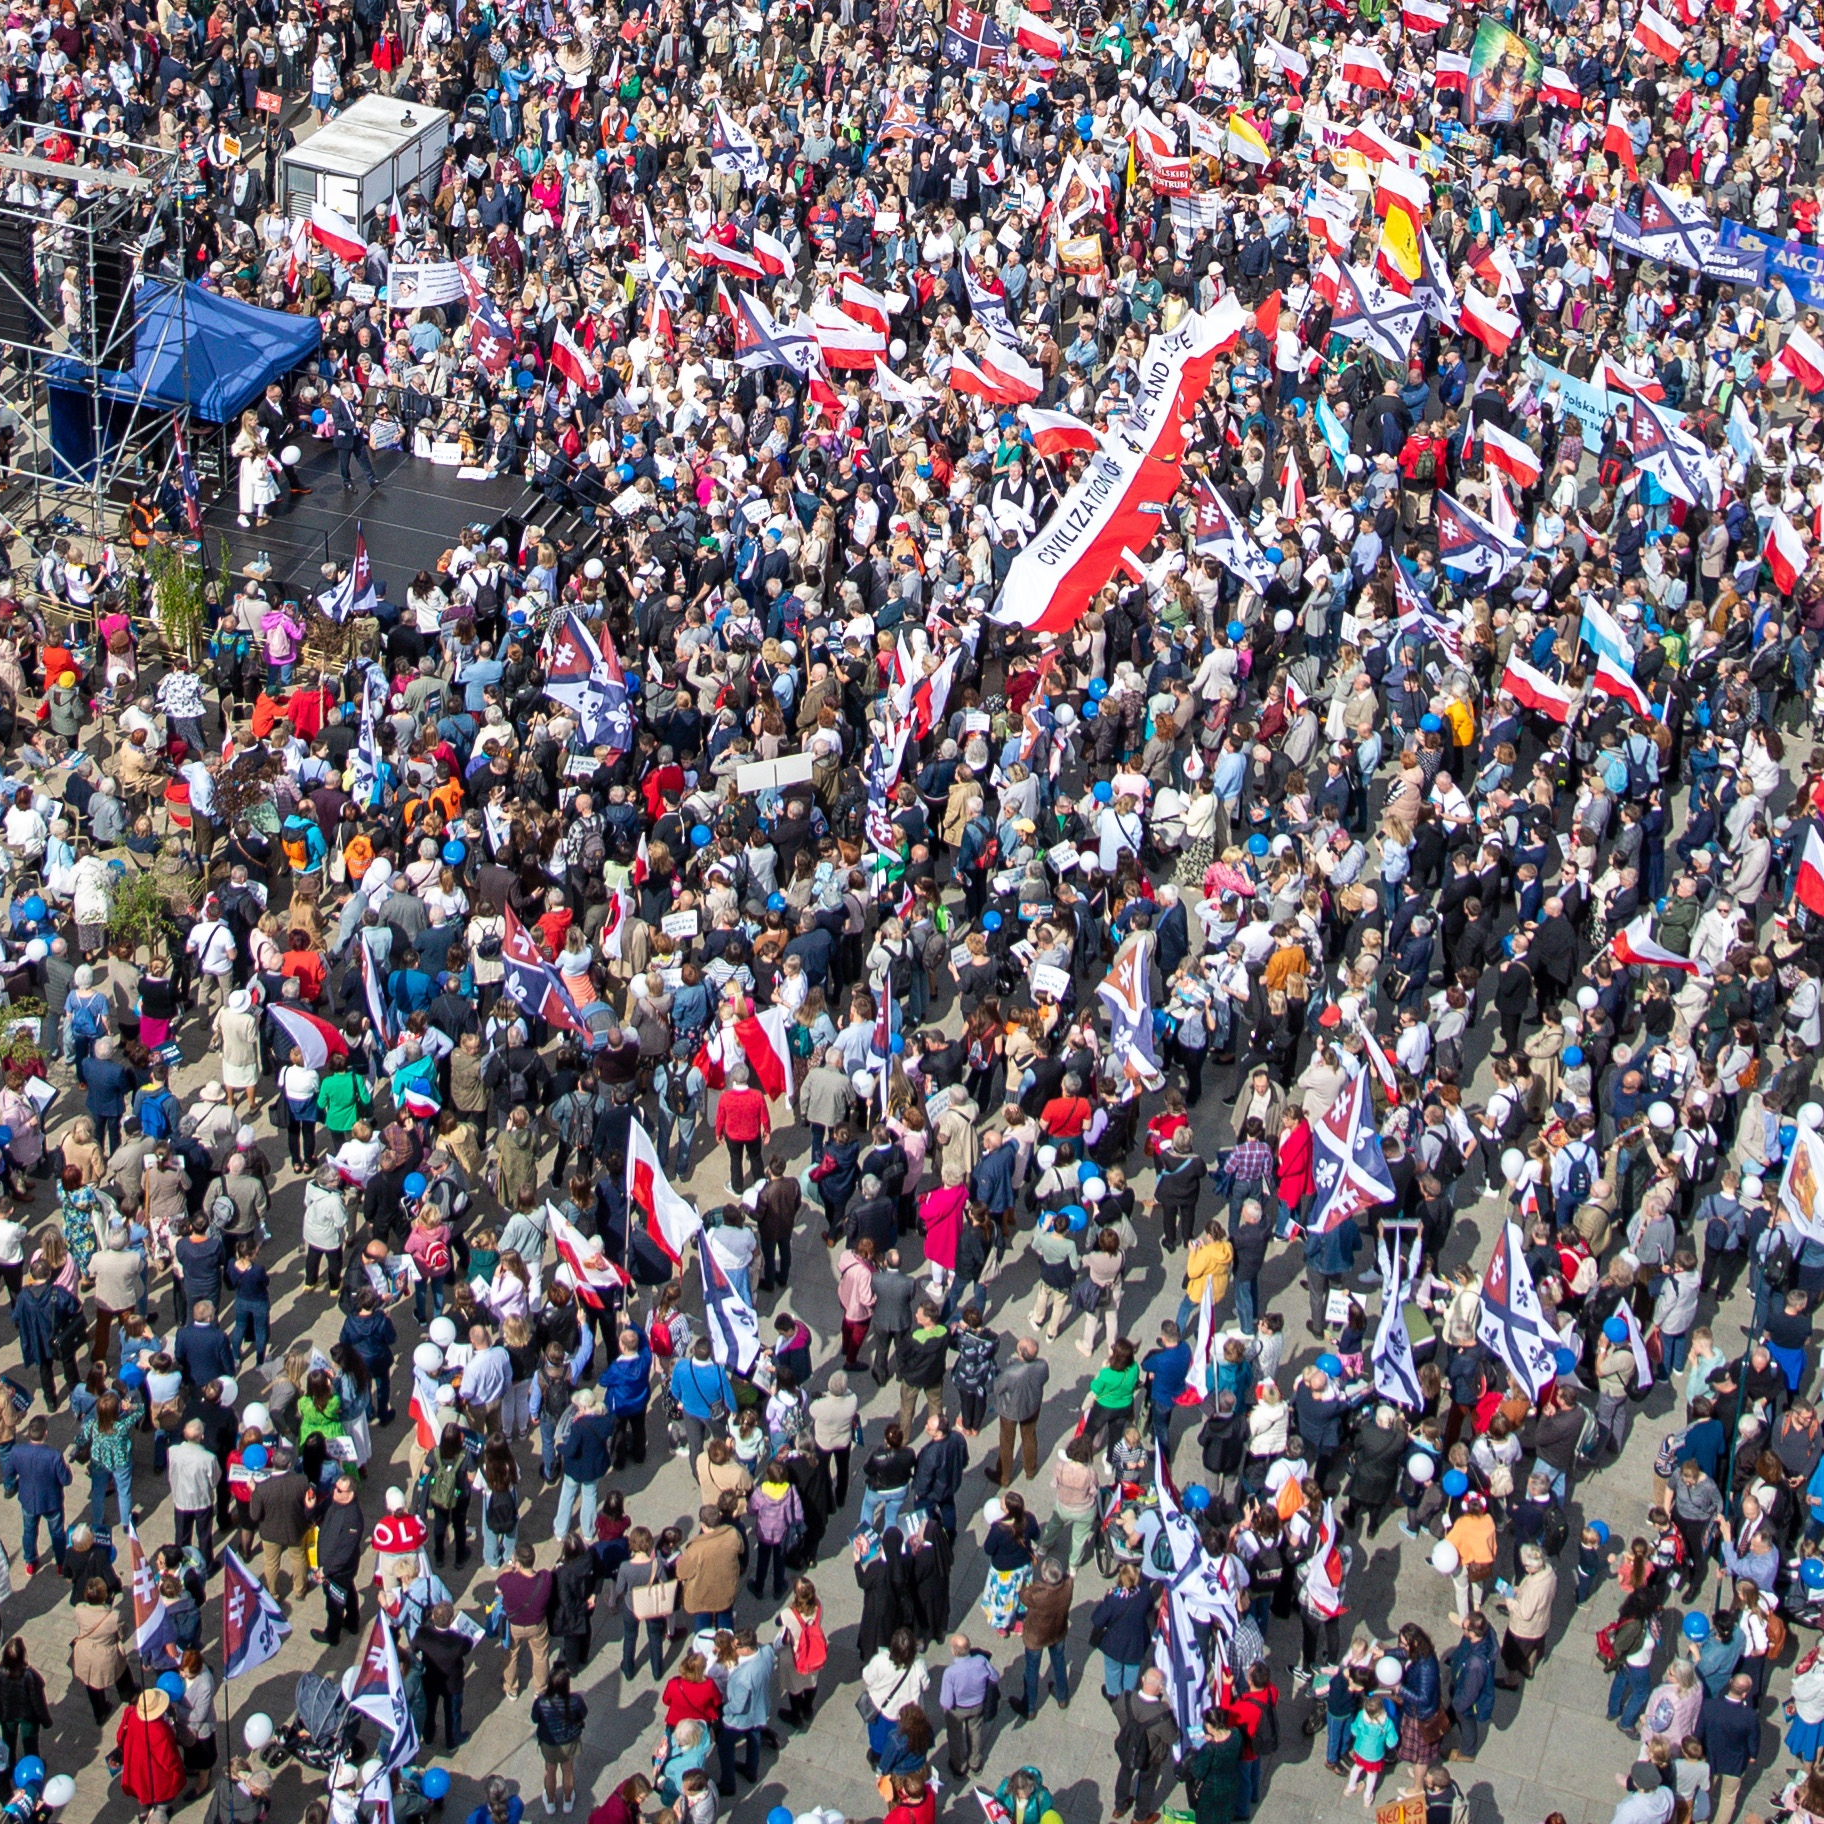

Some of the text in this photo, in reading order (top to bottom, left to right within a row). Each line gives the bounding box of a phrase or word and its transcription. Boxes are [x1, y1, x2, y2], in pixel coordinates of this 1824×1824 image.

[1133, 394, 1156, 433] LIFE
[1147, 363, 1170, 399] AND
[1563, 389, 1597, 416] Polska
[1037, 455, 1123, 568] CIVILIZATION OF
